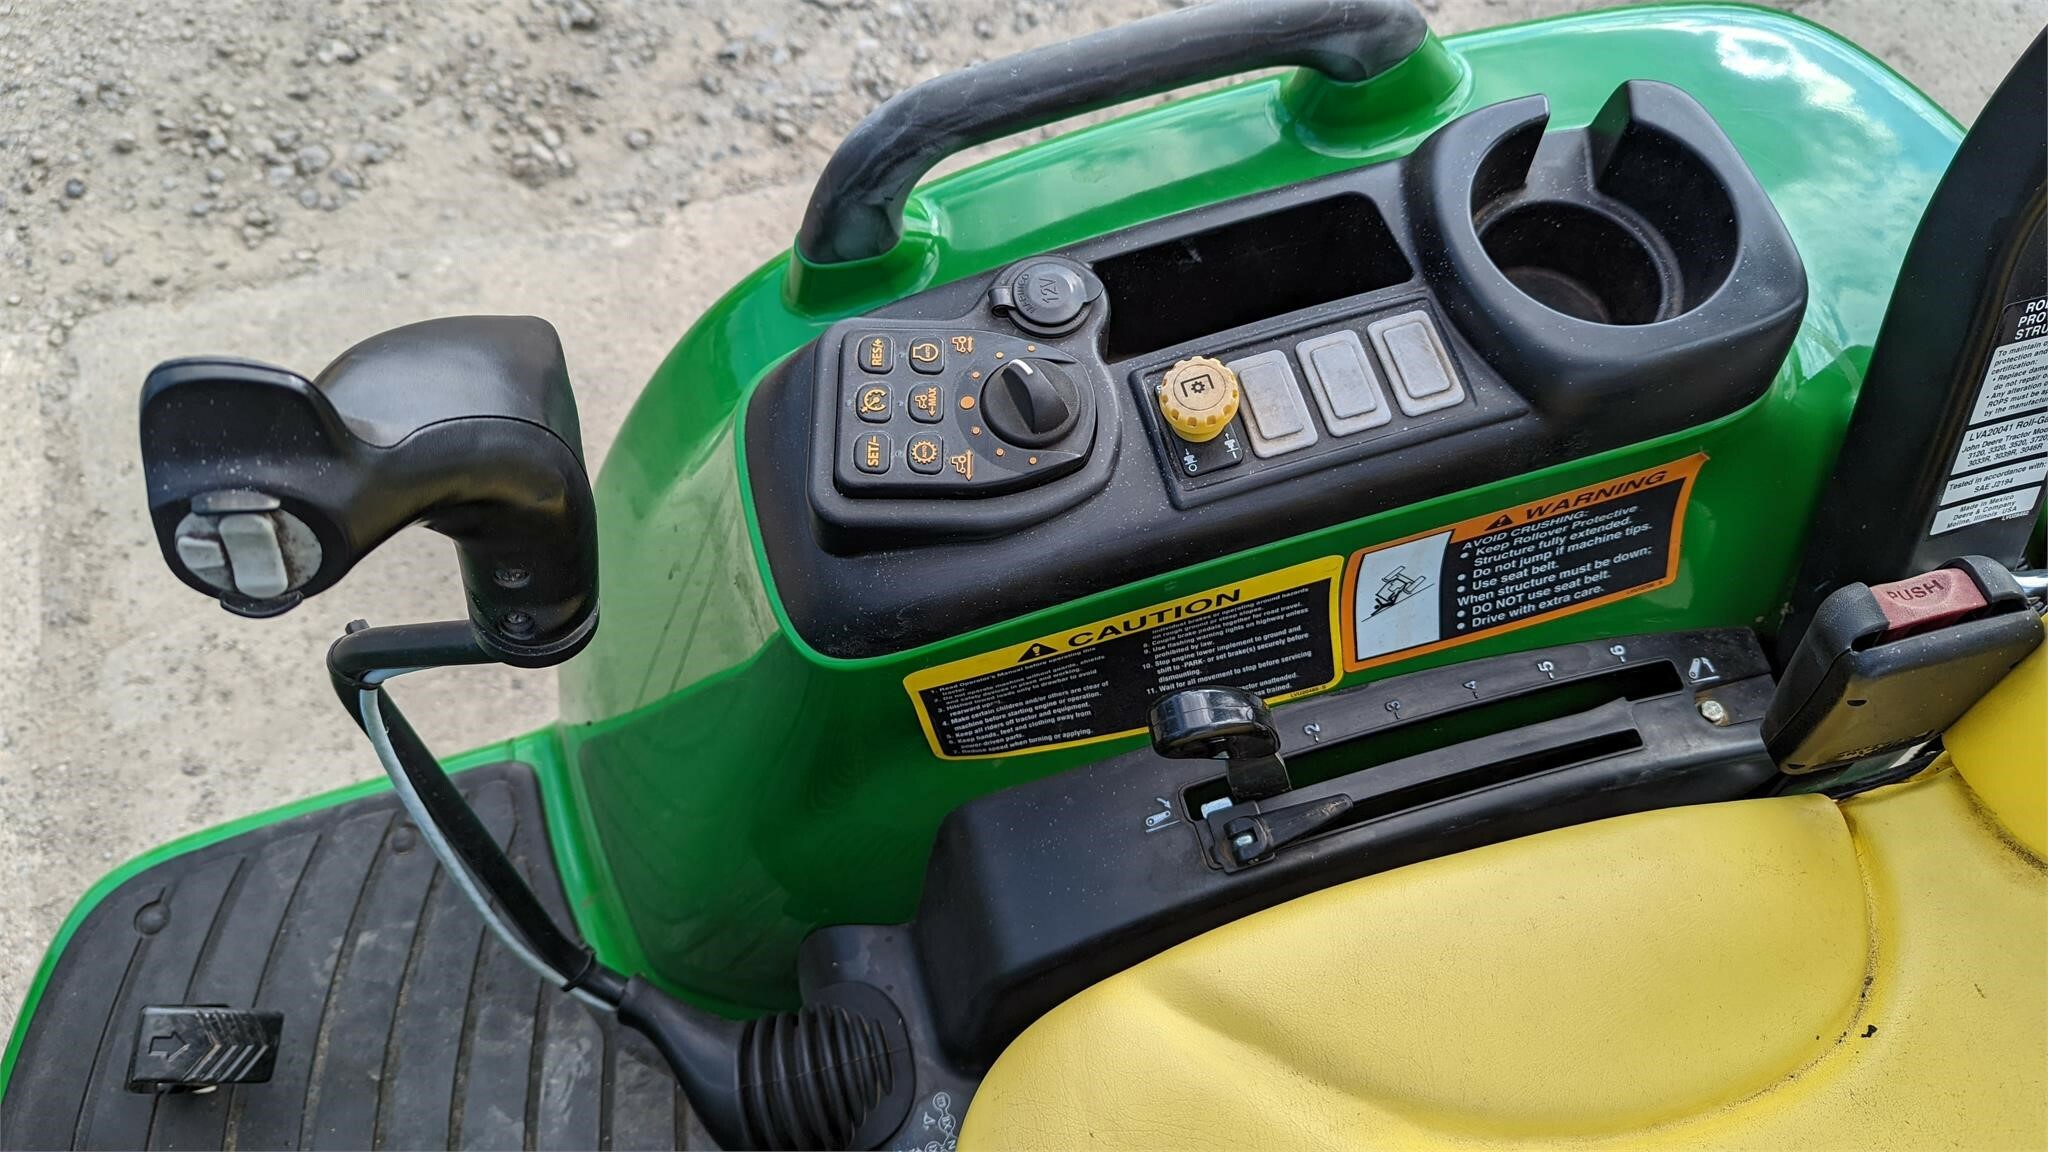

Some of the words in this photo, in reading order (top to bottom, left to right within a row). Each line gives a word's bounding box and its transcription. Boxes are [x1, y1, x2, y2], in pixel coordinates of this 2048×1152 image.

[1038, 278, 1060, 304] 12V
[2009, 342, 2042, 354] maintain
[1994, 352, 2033, 368] protection
[1998, 370, 2027, 382] Replace
[2005, 380, 2017, 388] not
[2018, 374, 2041, 386] repair
[928, 388, 936, 406] MAX
[1987, 397, 2010, 408] ROPS
[2010, 394, 2028, 402] must
[1990, 392, 2004, 400] Any
[2007, 383, 2042, 395] alteration
[1962, 444, 1980, 454] John
[1982, 438, 2004, 449] Deere
[2005, 430, 2031, 444] Tractor
[1969, 424, 2013, 442] LVA20041
[1949, 480, 1974, 490] Tested
[1974, 476, 1982, 484] in
[1983, 467, 2027, 482] accordance
[2028, 462, 2048, 470] with:
[1526, 470, 1667, 520] WARNING
[1974, 485, 1990, 494] SAE
[1960, 504, 1979, 512] Made
[1988, 494, 2015, 505] Mexico
[1982, 500, 2016, 512] Company
[1462, 532, 1508, 550] AVOID
[1510, 510, 1590, 538] CRUSHING:
[1474, 545, 1536, 566] Structure
[1538, 532, 1567, 549] fully
[1570, 516, 1632, 540] extended.
[1476, 542, 1510, 556] Keep
[1512, 524, 1569, 546] Rollover
[1571, 505, 1638, 530] Protective
[1472, 568, 1491, 578] Do
[1494, 560, 1516, 572] not
[1519, 551, 1552, 568] jump
[1555, 546, 1565, 556] if
[1567, 532, 1622, 552] machine
[1625, 523, 1652, 536] tips.
[1456, 591, 1494, 606] When
[1497, 574, 1556, 596] structure
[1559, 562, 1592, 579] must
[1594, 558, 1611, 570] be
[1472, 578, 1498, 590] Use
[1500, 568, 1528, 582] seat
[1531, 560, 1559, 575] belt.
[1472, 602, 1492, 616] DO
[1495, 592, 1525, 609] NOT
[1527, 588, 1551, 600] use
[1554, 578, 1581, 592] seat
[1584, 570, 1612, 584] belt.
[1886, 580, 1944, 600] PUSH
[1068, 590, 1240, 646] CAUTION
[1472, 612, 1506, 628] Drive
[1508, 604, 1536, 618] with
[1538, 594, 1571, 609] extra
[1574, 586, 1604, 600] care.
[1168, 638, 1194, 648] flashing
[1196, 631, 1224, 640] warning
[1225, 624, 1244, 634] lights
[1256, 614, 1284, 625] highway
[1286, 608, 1309, 618] unless
[1154, 645, 1190, 660] prohibited
[1155, 659, 1170, 667] Stop
[1172, 654, 1195, 662] engine
[1196, 648, 1216, 656] lower
[1216, 637, 1254, 652] implement
[1262, 629, 1287, 640] ground
[1288, 624, 1302, 634] and
[1156, 666, 1172, 674] shift
[1216, 652, 1226, 660] set
[1228, 646, 1256, 658] brake(s)
[1256, 638, 1286, 650] securely
[1286, 632, 1309, 643] before
[1609, 644, 1626, 656] 6
[1158, 683, 1175, 692] Wait
[1197, 670, 1234, 683] movement
[1242, 664, 1257, 673] stop
[1258, 658, 1280, 668] before
[1280, 650, 1312, 663] servicing
[1158, 669, 1202, 683] dismounting.
[1538, 660, 1554, 672] 5
[1462, 680, 1477, 690] 4
[950, 716, 970, 724] Make
[971, 708, 995, 719] certain
[996, 701, 1024, 712] children
[1048, 690, 1069, 700] others
[1082, 683, 1100, 692] clear
[1384, 700, 1400, 712] 3
[954, 720, 984, 732] machine
[984, 714, 1006, 724] before
[1008, 706, 1034, 718] starting
[1034, 700, 1058, 710] engine
[984, 722, 1004, 732] riders
[1016, 712, 1038, 723] tractor
[1038, 710, 1052, 718] and
[1014, 723, 1028, 732] and
[1028, 718, 1056, 728] clothing
[1056, 714, 1074, 722] away
[1076, 710, 1092, 718] from
[1303, 723, 1320, 736] 2
